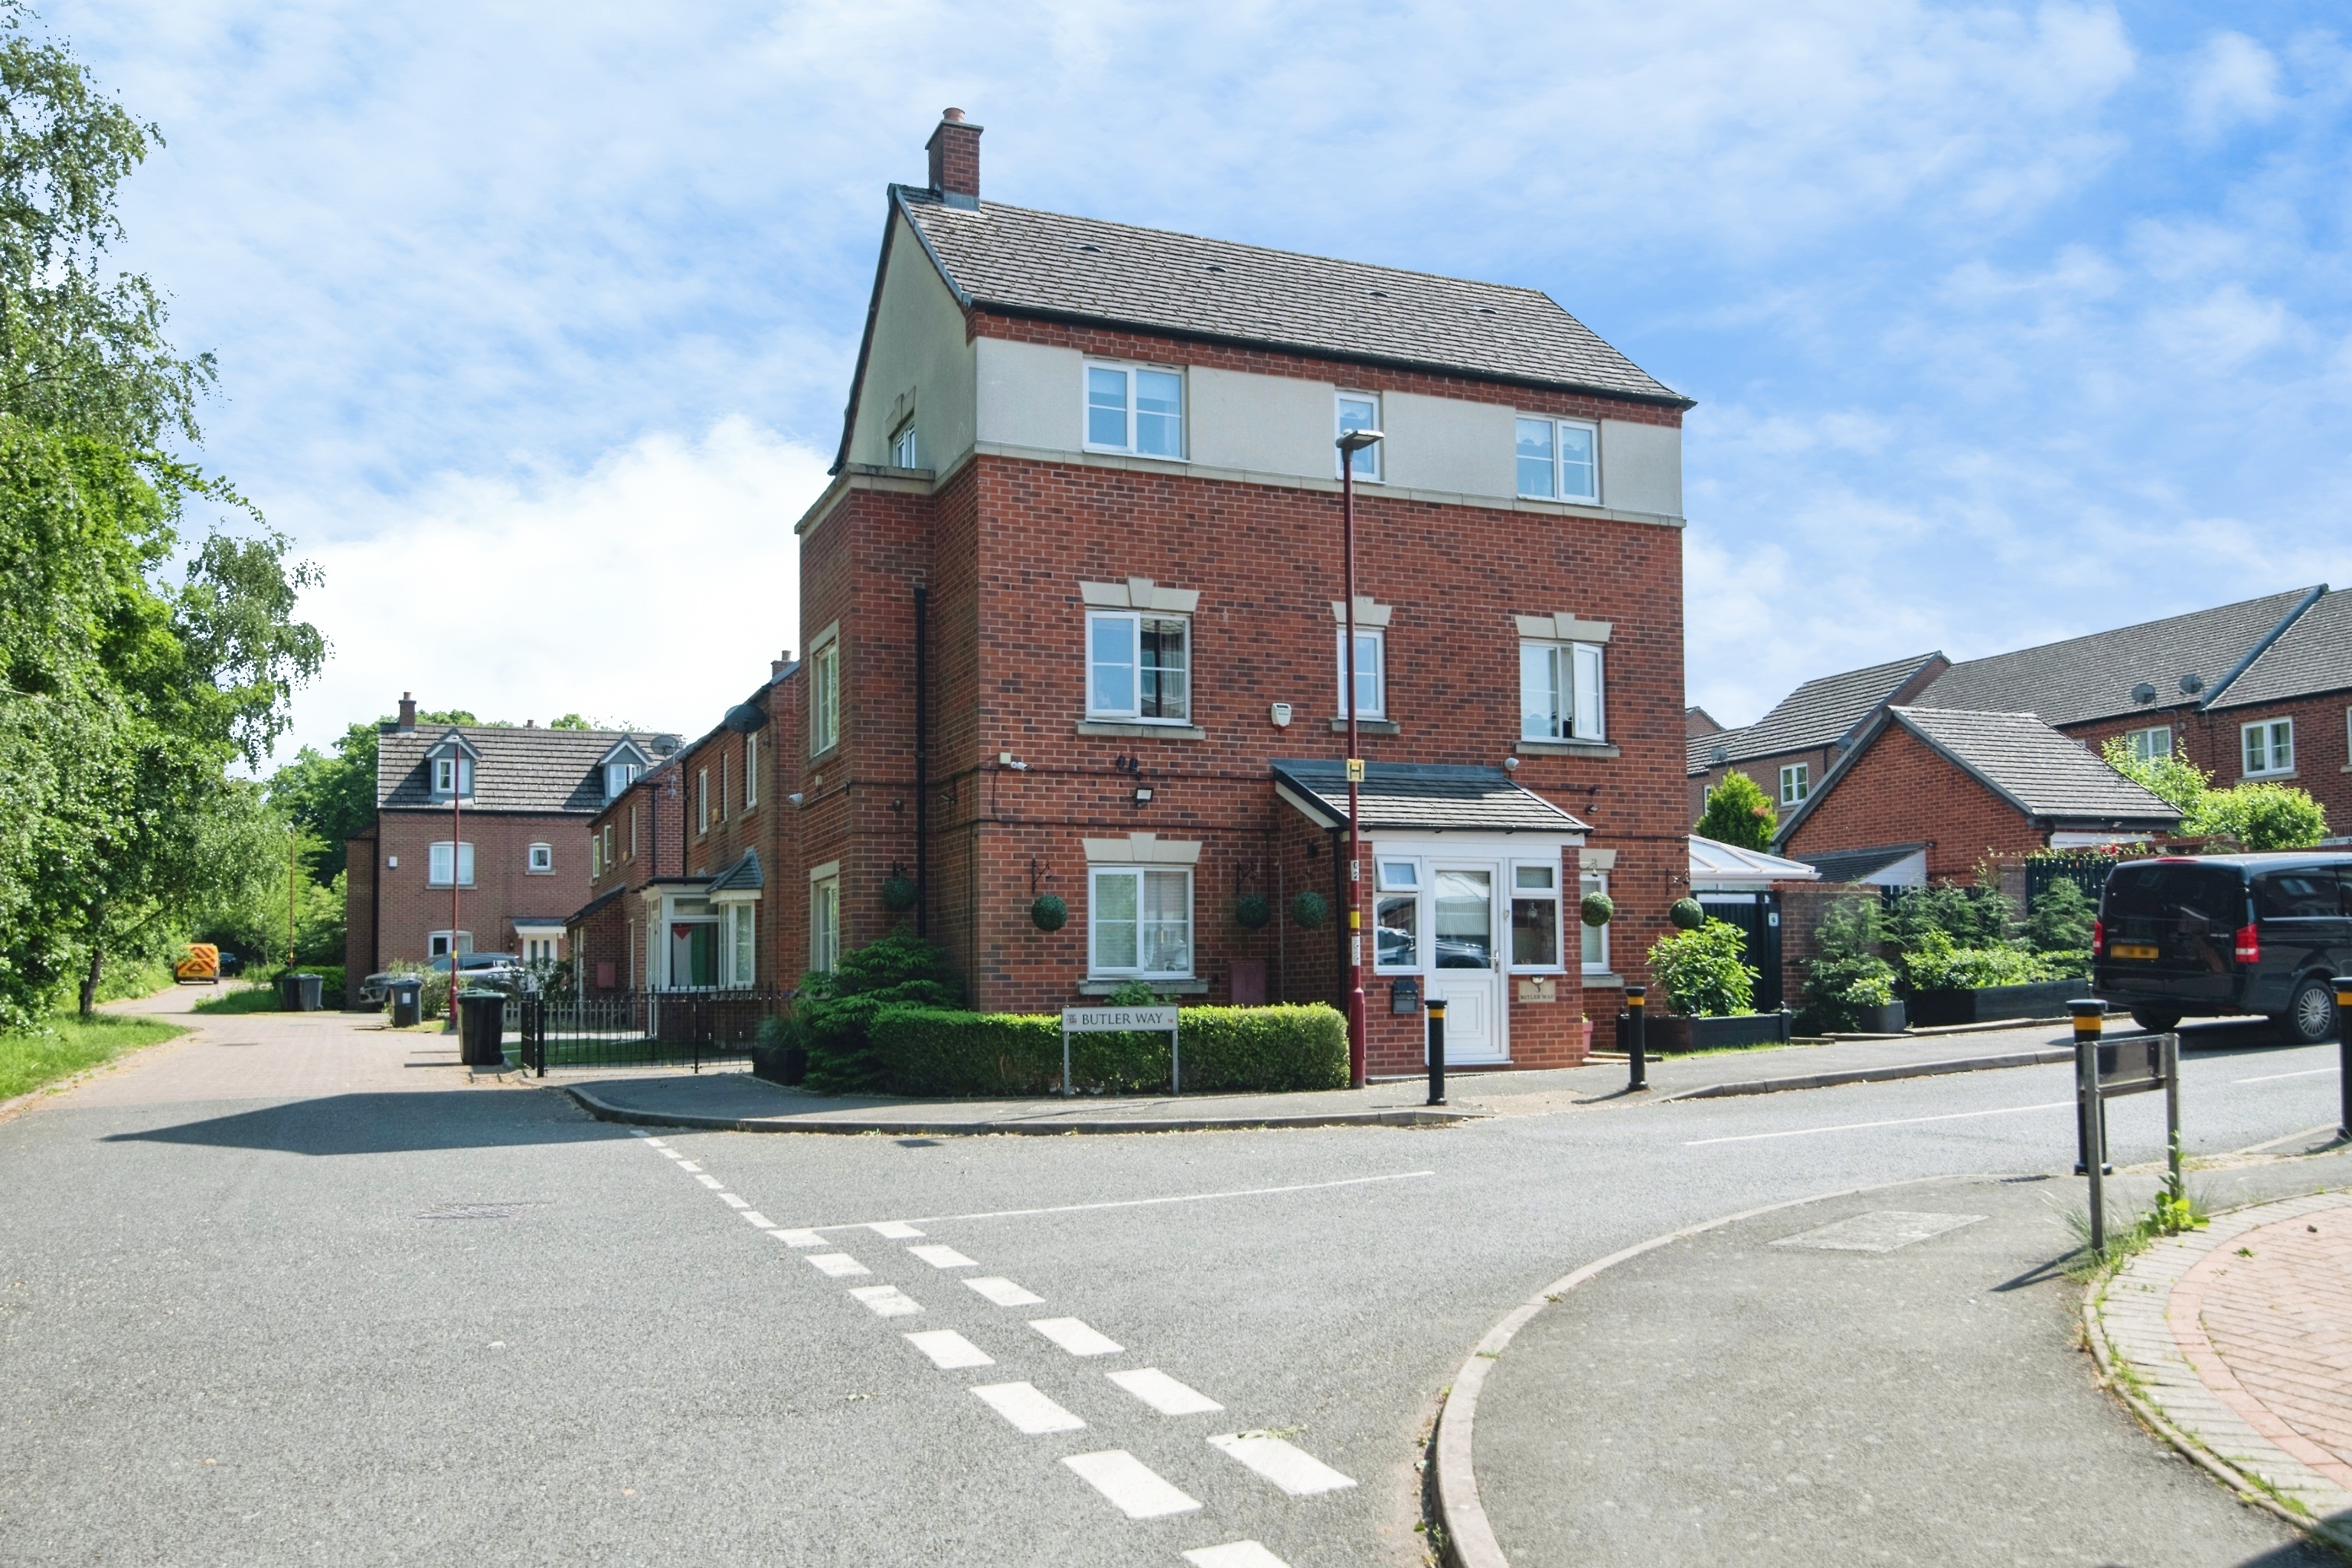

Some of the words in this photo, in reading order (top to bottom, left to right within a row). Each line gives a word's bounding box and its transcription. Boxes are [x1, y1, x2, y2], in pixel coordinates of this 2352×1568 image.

[1349, 762, 1361, 779] H
[1082, 1013, 1132, 1025] BUTLER
[1135, 1012, 1163, 1024] WAY
